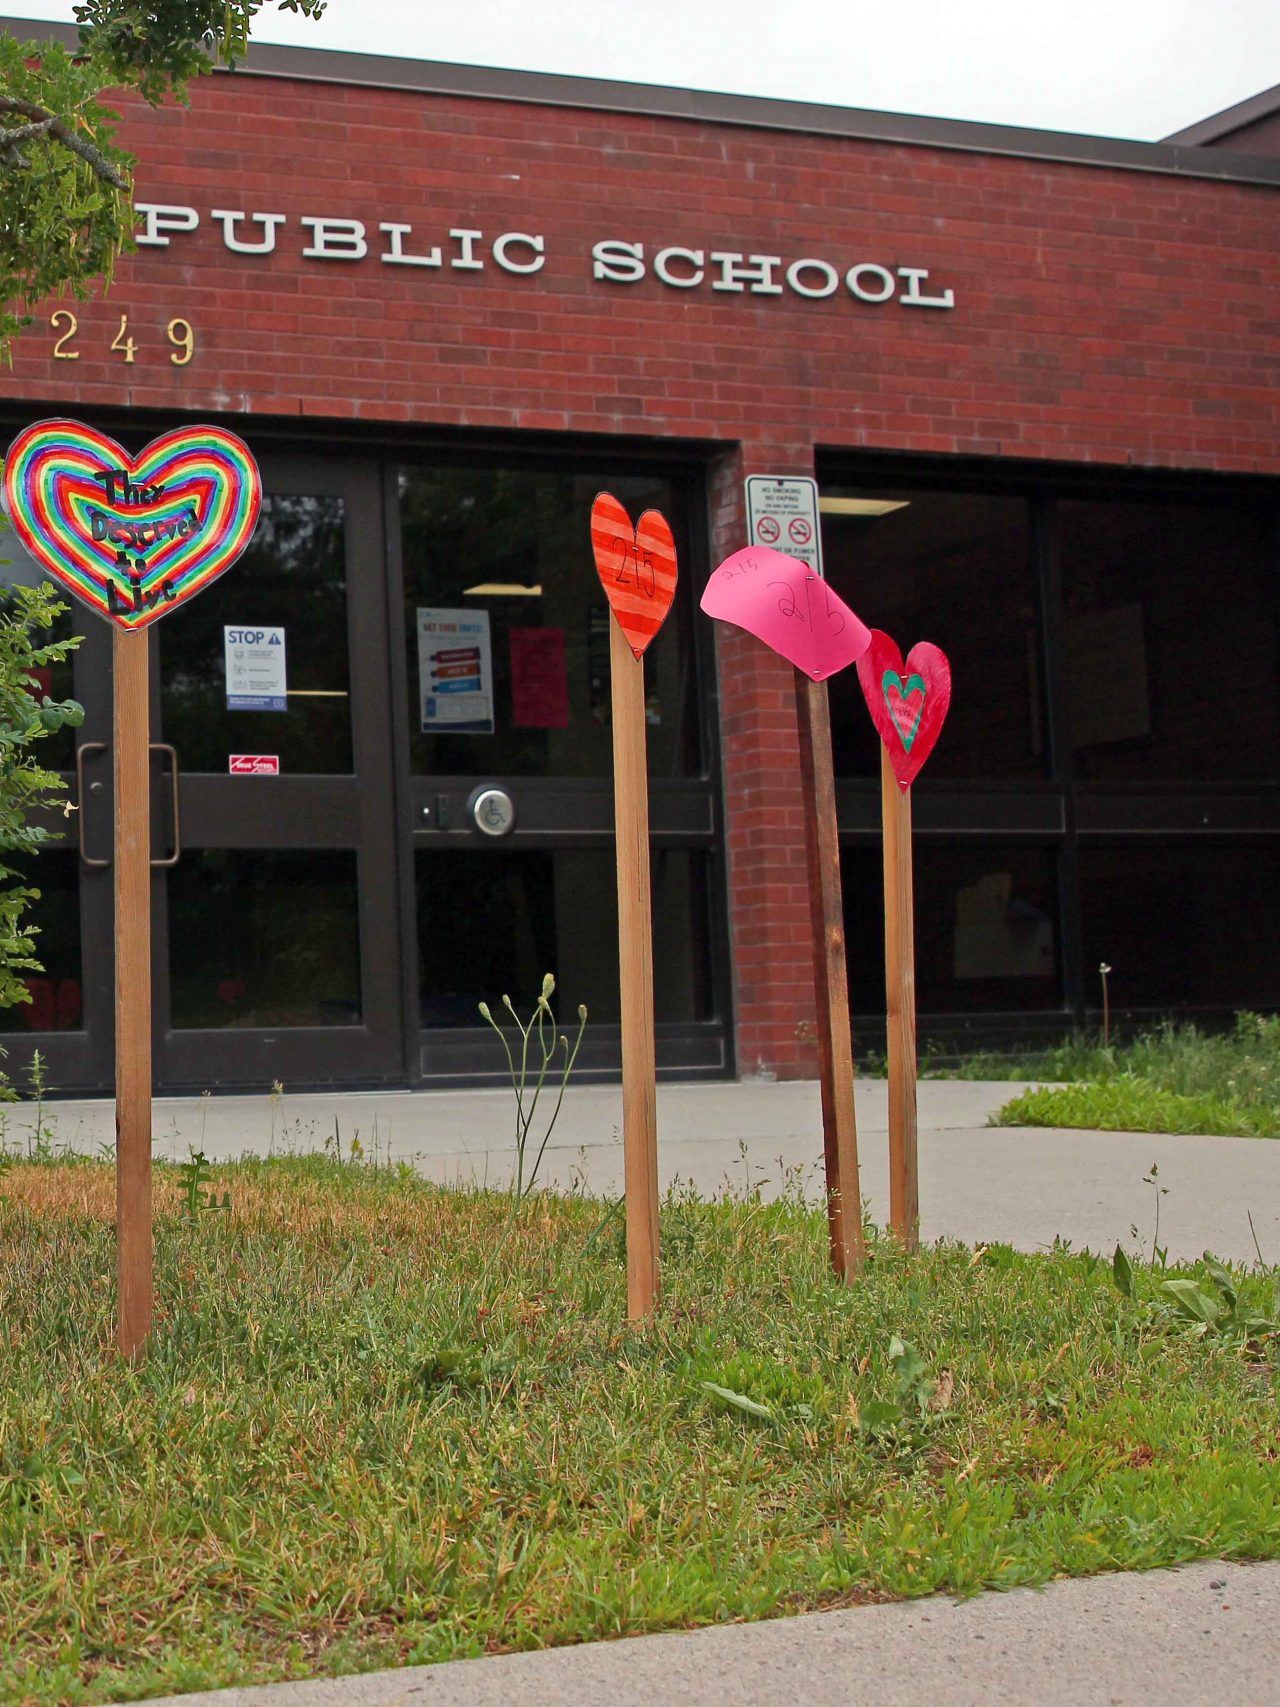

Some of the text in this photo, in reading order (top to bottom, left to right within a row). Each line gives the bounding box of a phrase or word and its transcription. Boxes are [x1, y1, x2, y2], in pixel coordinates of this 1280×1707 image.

[133, 202, 955, 308] PUBLIC SCHOOL
[50, 309, 195, 366] 249
[93, 469, 165, 506] They
[91, 508, 203, 549] Deserved
[114, 550, 147, 576] to
[612, 537, 657, 598] 215
[721, 558, 759, 580] 215
[105, 577, 177, 616] Live
[766, 580, 846, 638] 215
[228, 630, 265, 644] STOP
